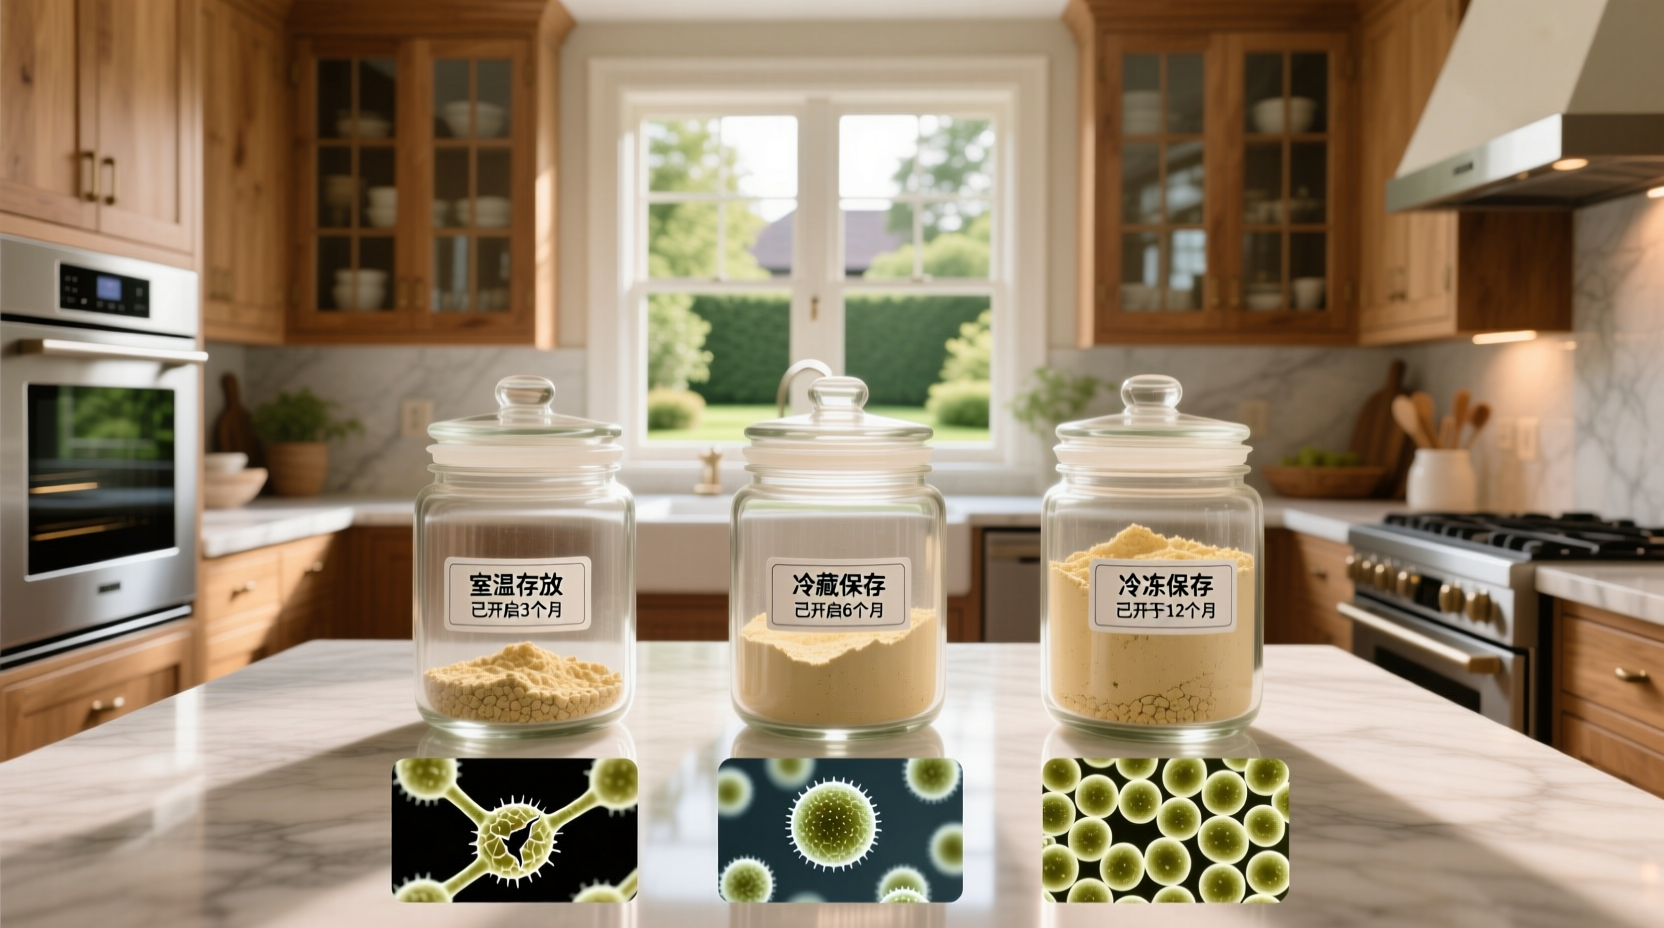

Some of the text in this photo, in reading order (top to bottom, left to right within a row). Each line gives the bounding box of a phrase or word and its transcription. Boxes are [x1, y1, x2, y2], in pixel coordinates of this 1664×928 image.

[469, 571, 564, 598] 室温存放
[792, 571, 886, 598] 冷藏保存
[1118, 572, 1214, 598] 冷冻保存
[470, 600, 562, 619] 已开启3个月
